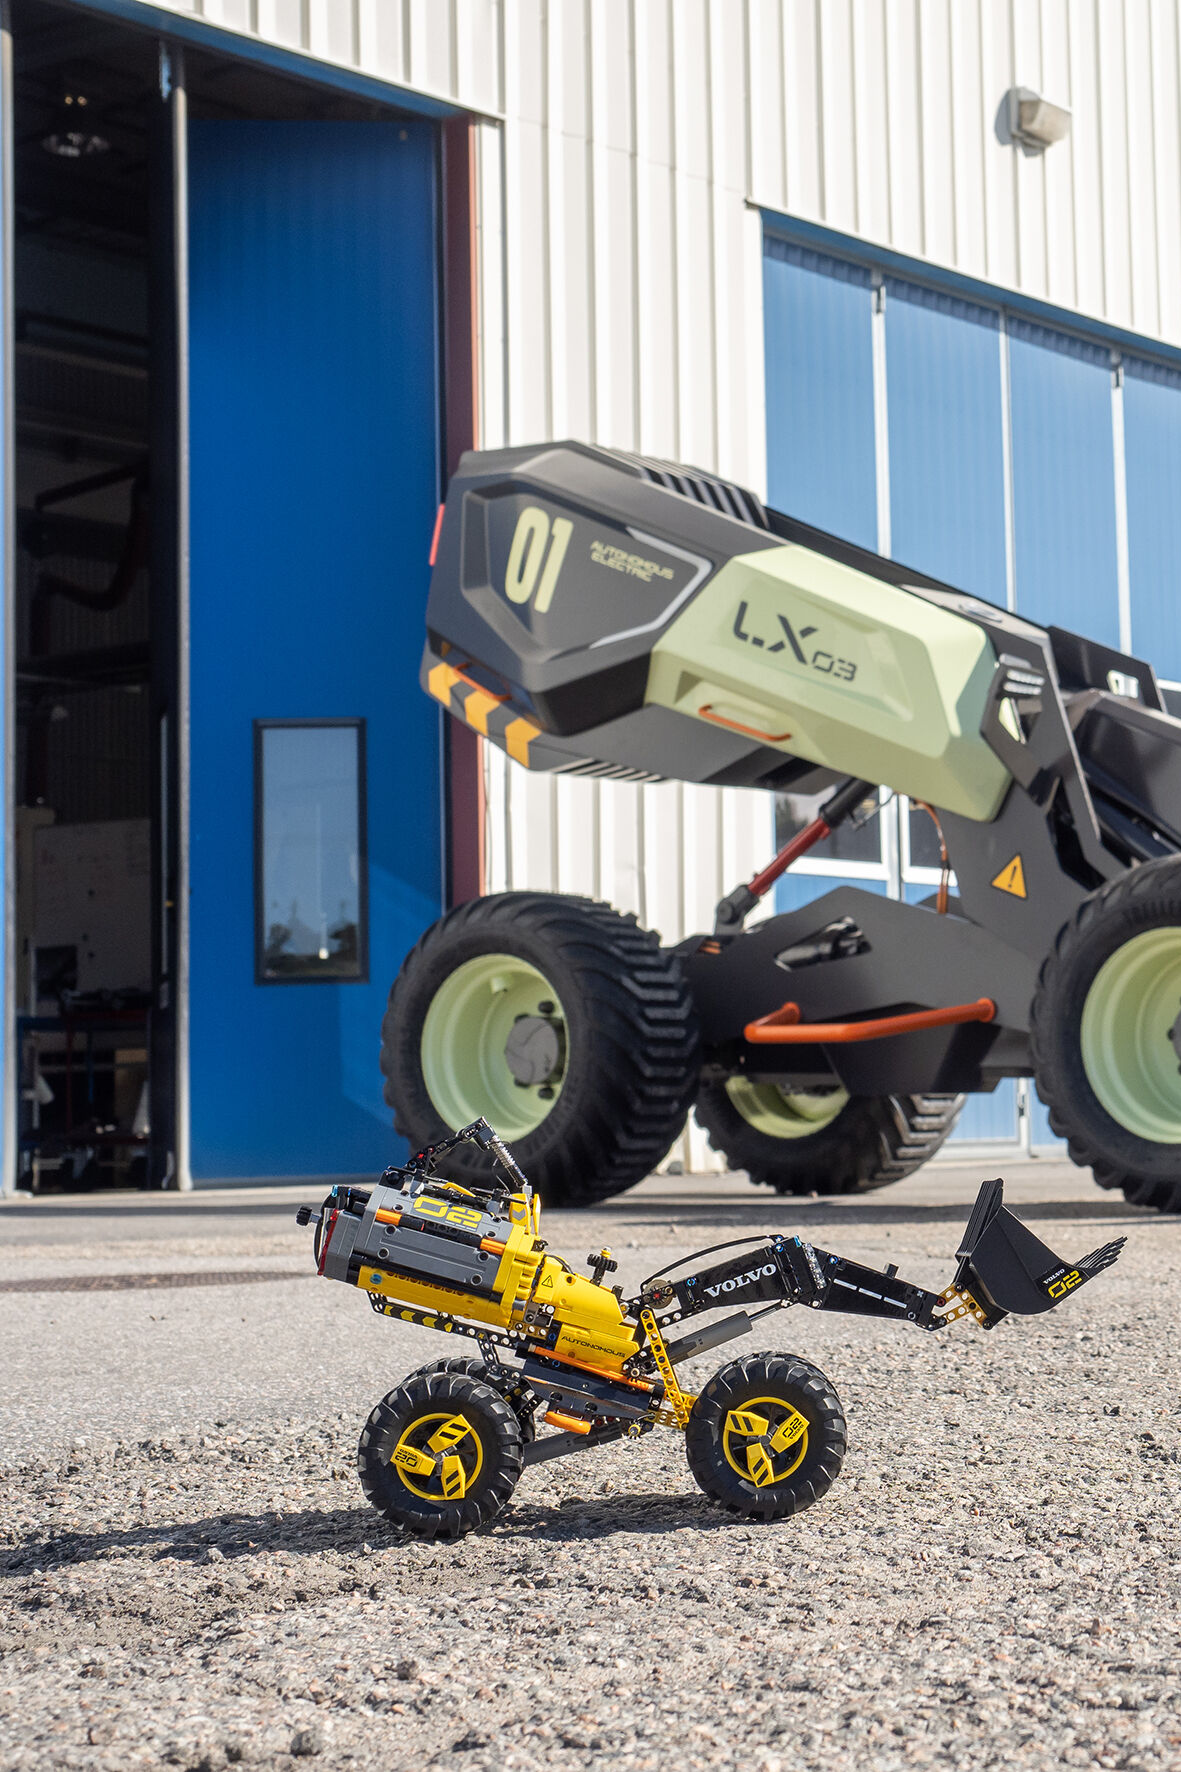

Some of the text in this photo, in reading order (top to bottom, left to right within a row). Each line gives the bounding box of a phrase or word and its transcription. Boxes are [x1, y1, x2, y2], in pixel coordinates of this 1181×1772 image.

[505, 506, 574, 614] 01
[591, 540, 674, 580] AUTONOMOUS
[591, 551, 652, 583] ELECTRIC
[413, 1196, 483, 1229] 02
[703, 1263, 777, 1298] VOLVO
[1043, 1268, 1065, 1284] VOLVO
[1047, 1270, 1082, 1299] 02
[561, 1335, 626, 1358] AUTONOMOUS
[782, 1417, 802, 1438] 02
[394, 1451, 418, 1468] 02
